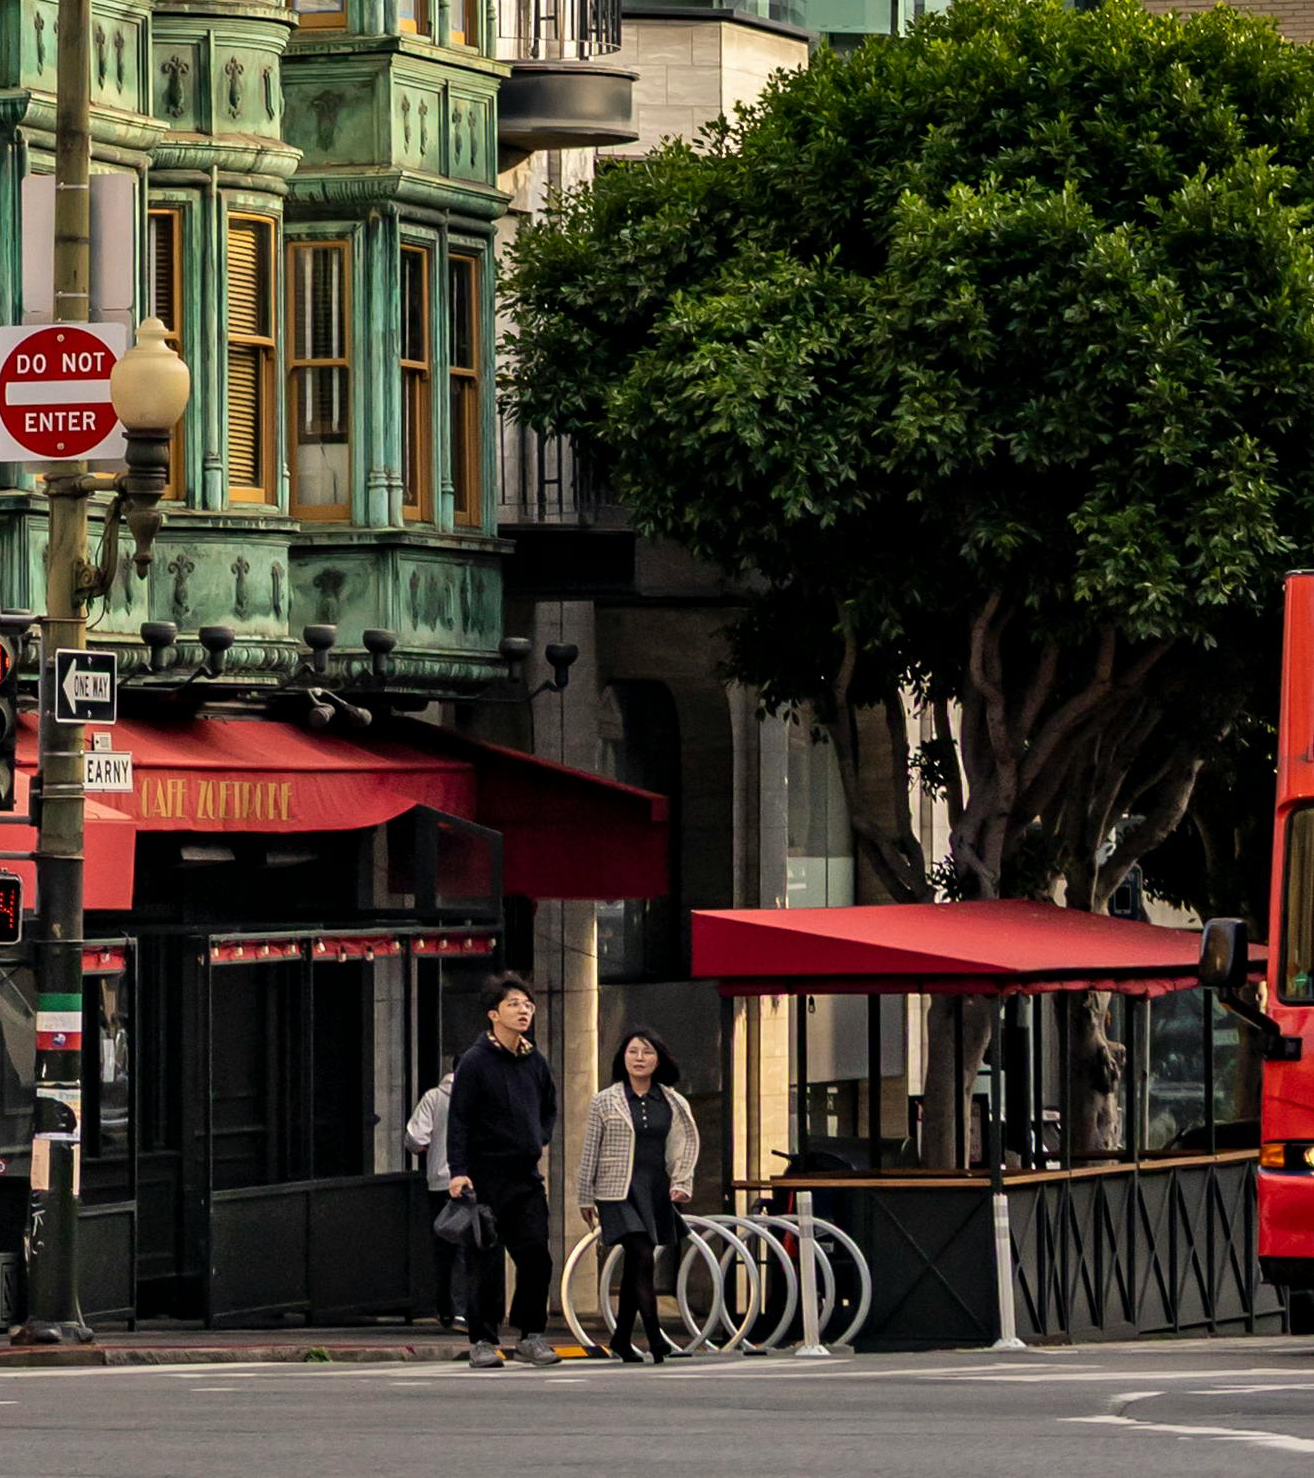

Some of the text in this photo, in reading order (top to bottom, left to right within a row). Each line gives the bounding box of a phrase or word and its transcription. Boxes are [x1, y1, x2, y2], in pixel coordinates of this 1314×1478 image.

[16, 352, 105, 374] DO NOT
[24, 411, 96, 433] ENTER
[74, 676, 109, 699] ONE WAY
[87, 760, 130, 784] EARNY
[141, 776, 292, 822] CAFE ZOETROPE
